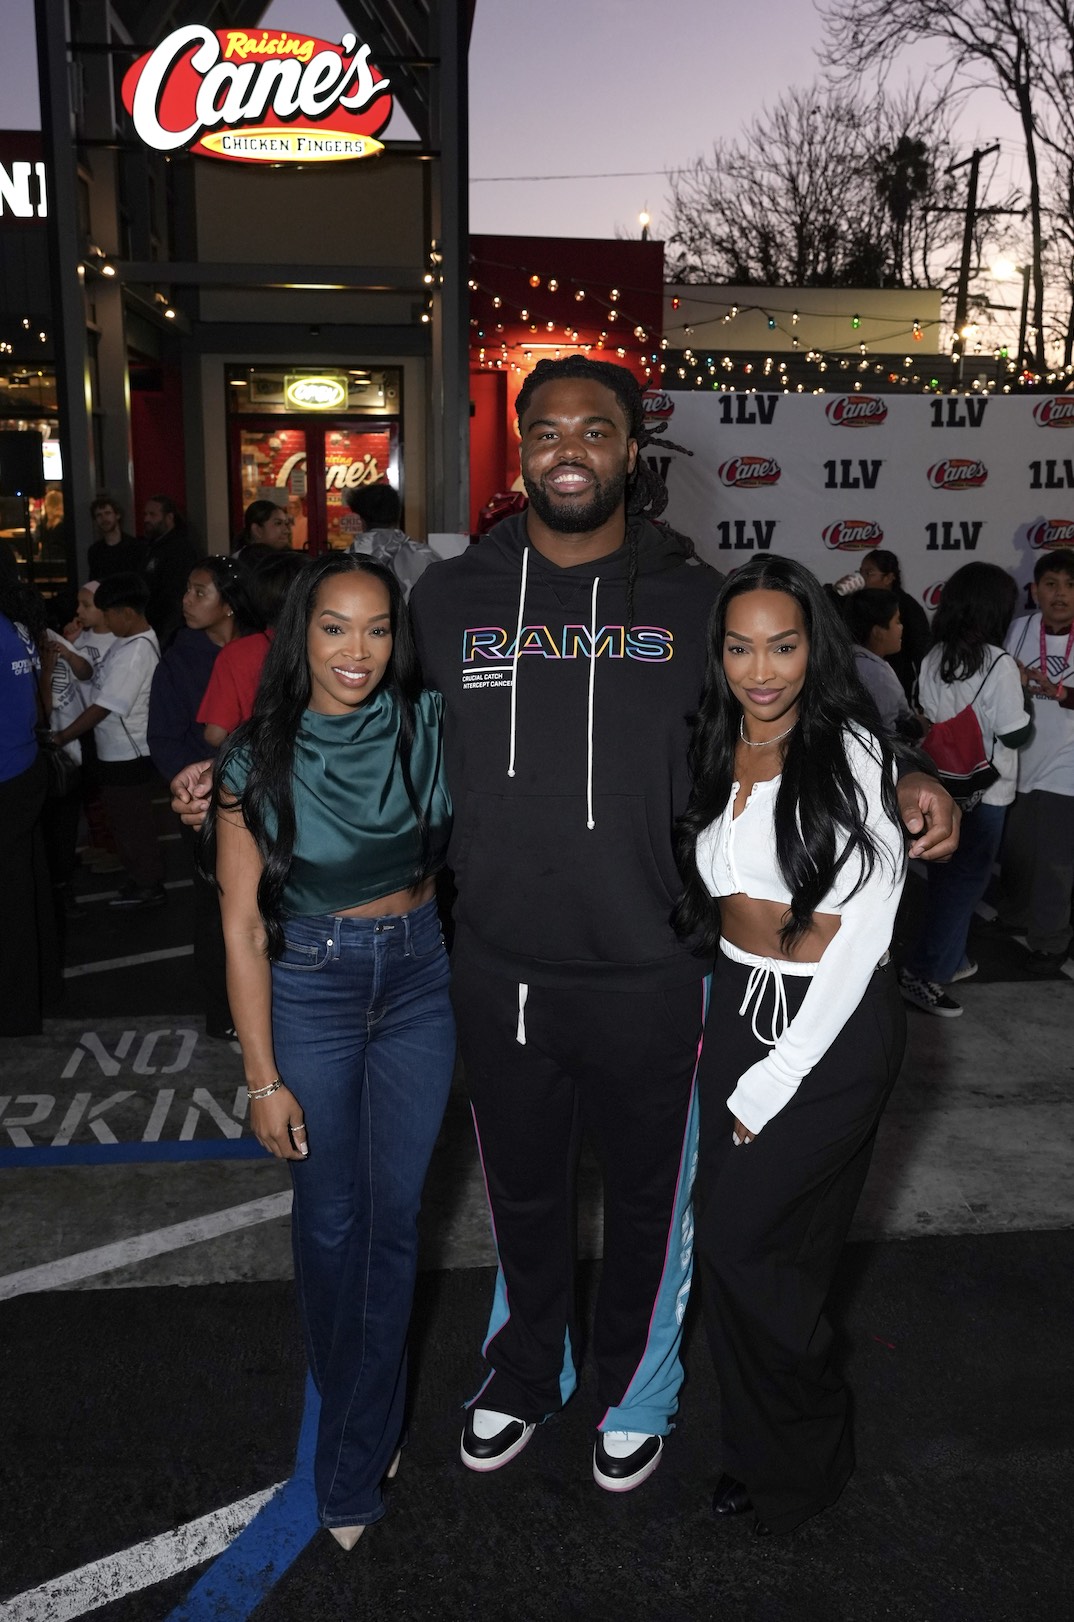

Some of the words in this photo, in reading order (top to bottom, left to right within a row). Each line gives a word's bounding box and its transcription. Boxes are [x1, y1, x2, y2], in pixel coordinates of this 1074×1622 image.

[225, 32, 315, 62] Raising
[133, 25, 390, 150] Cane's
[718, 394, 779, 425] 1LV
[827, 395, 887, 426] Cane's
[931, 398, 988, 428] 1LV
[720, 456, 781, 487] Cane's
[823, 459, 882, 490] 1LV
[929, 459, 988, 489] Cane's
[717, 520, 776, 550] 1LV
[824, 520, 884, 550] Cane's
[925, 522, 983, 551] 1LV
[463, 625, 674, 663] RAMS
[462, 674, 483, 682] CRUCIAL
[61, 1029, 199, 1078] NO
